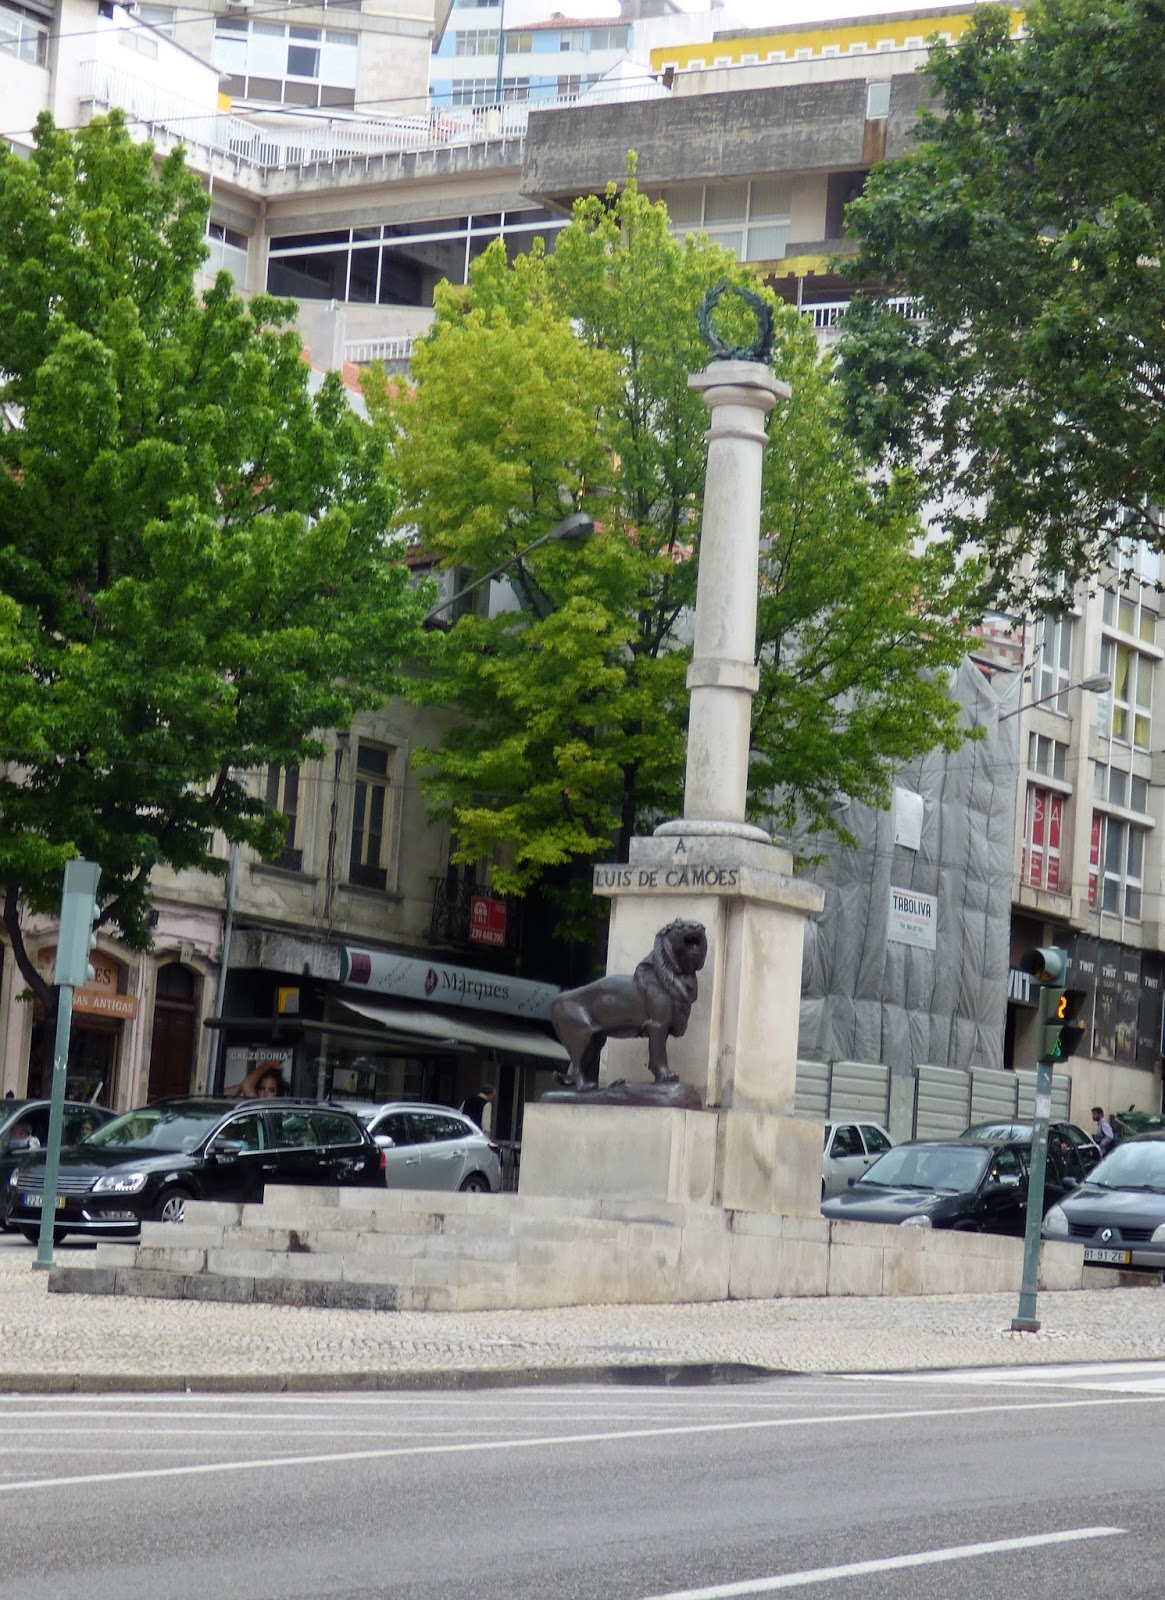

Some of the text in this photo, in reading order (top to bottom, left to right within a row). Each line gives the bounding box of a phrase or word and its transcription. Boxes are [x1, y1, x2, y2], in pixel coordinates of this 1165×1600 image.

[674, 837, 687, 854] A
[595, 871, 632, 887] LUIS
[638, 871, 659, 887] DE
[893, 896, 931, 918] TABOLIVA
[442, 971, 509, 1001] Marques
[93, 998, 133, 1013] ANTIGAS
